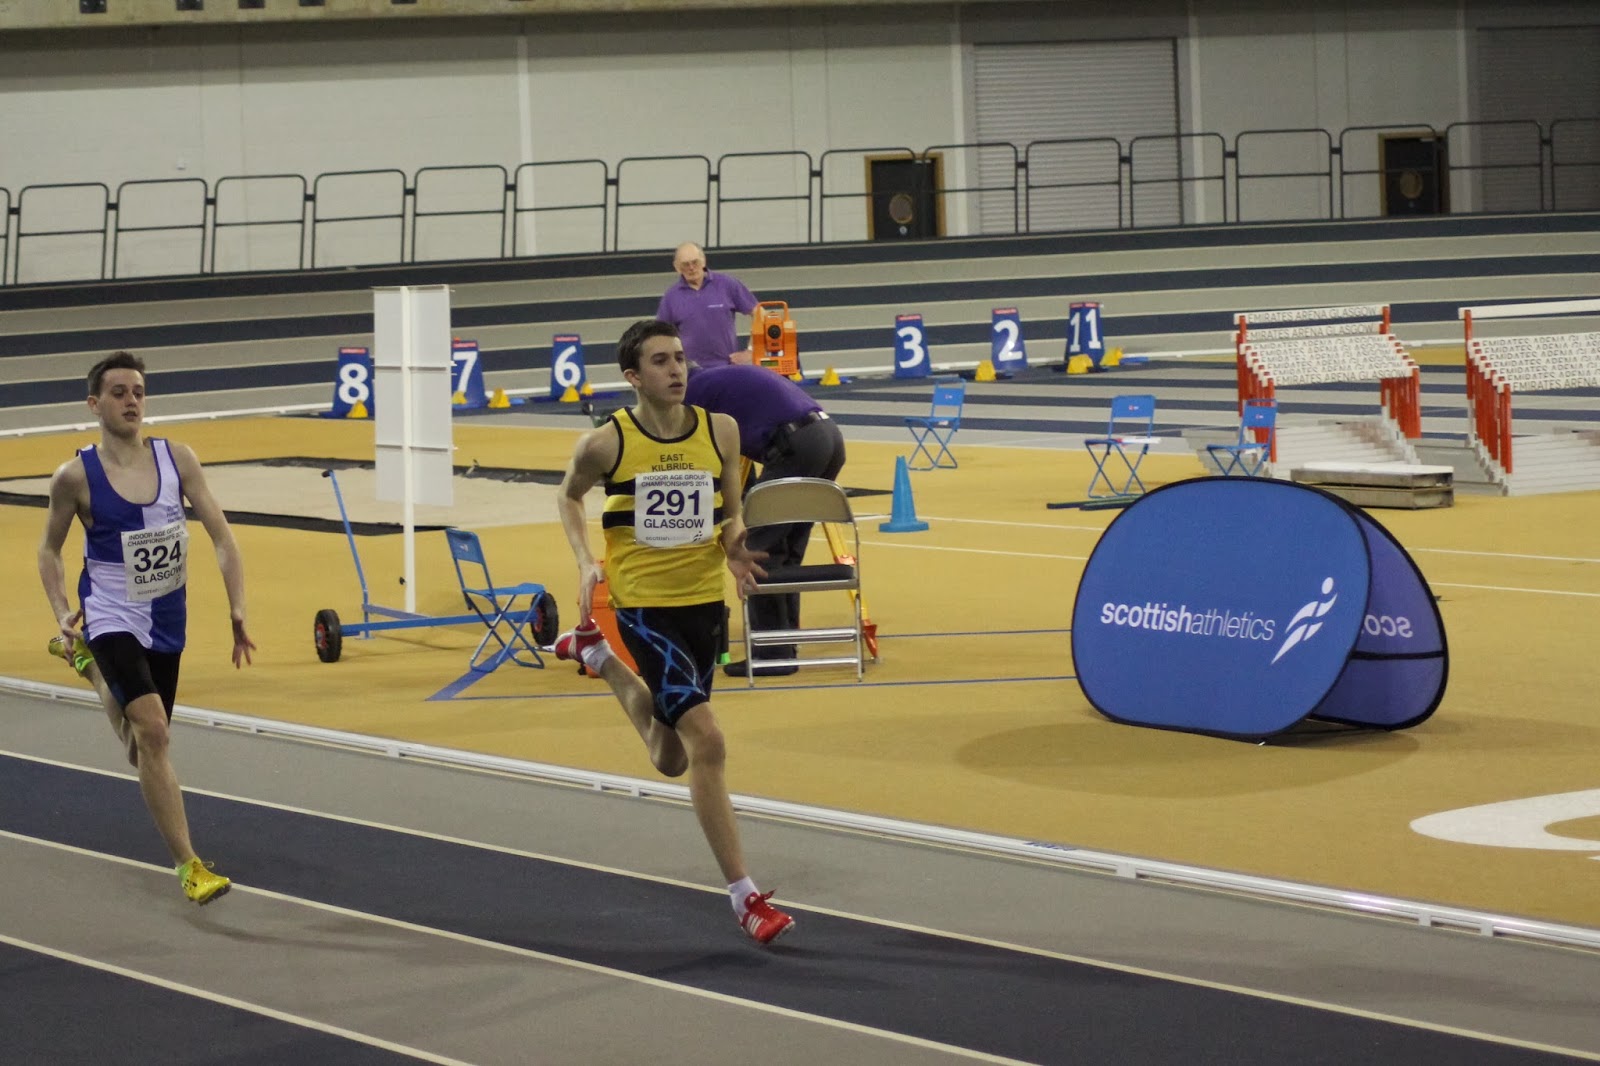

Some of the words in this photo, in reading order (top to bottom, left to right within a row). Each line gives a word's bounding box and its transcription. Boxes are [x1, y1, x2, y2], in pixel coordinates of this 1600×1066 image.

[896, 326, 925, 369] 3
[993, 319, 1023, 362] 2
[453, 350, 479, 396] 7
[554, 345, 582, 388] 6
[338, 362, 370, 405] 8
[651, 463, 695, 472] KILBRIDE
[660, 454, 684, 462] EAST
[641, 480, 694, 488] CHAMPIONSHIPS
[646, 489, 701, 516] 291
[128, 532, 153, 541] INDOOR
[643, 518, 705, 529] GLASGOW
[133, 540, 182, 573] 324
[134, 564, 184, 585] GLASGOW
[1100, 602, 1276, 641] scottishathletics
